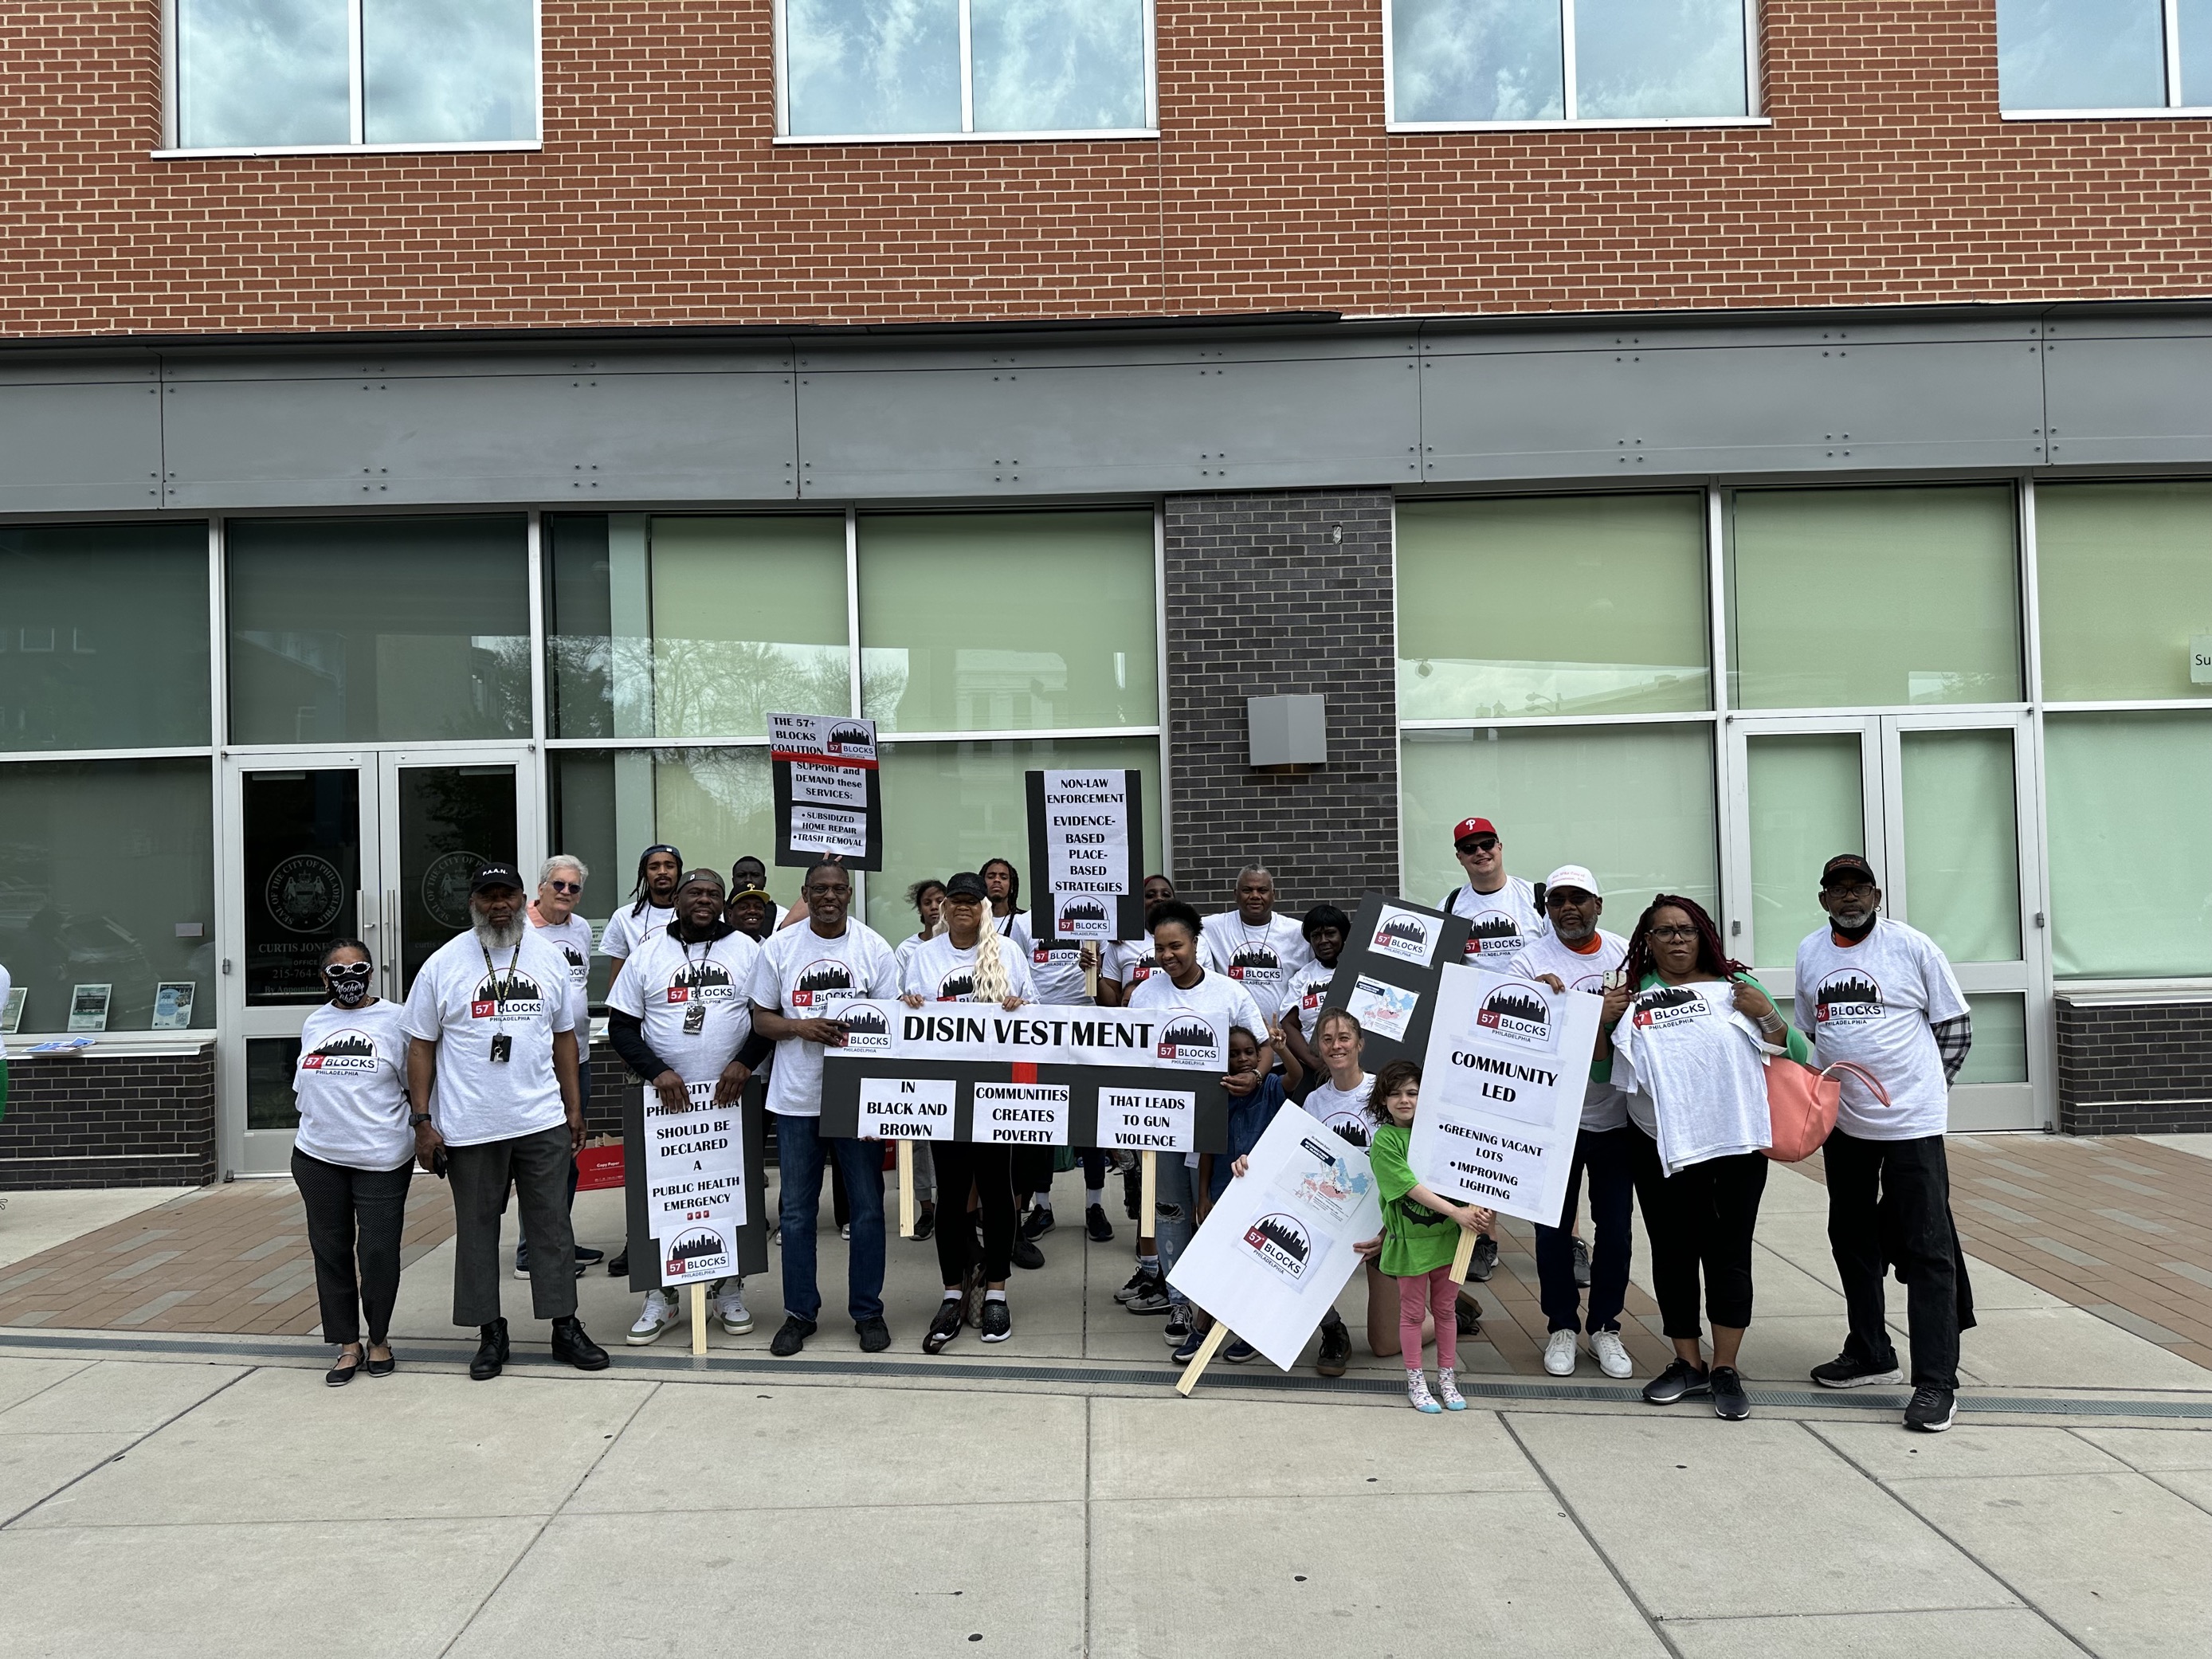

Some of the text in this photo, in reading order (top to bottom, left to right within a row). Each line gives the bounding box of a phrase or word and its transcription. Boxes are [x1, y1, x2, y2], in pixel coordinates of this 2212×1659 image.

[773, 717, 816, 728] THE 57+
[776, 730, 816, 741] BLOCKS
[771, 743, 824, 755] COALITION
[843, 746, 873, 755] BLOCKS
[797, 762, 839, 773] SUPPORT
[795, 775, 862, 789] DEMAND these
[1061, 779, 1109, 789] NON-LAW
[806, 787, 853, 800] SERVICES:
[1047, 794, 1124, 804] ENFORCEMENT
[806, 811, 854, 823] SUBSIDIZED
[1053, 816, 1116, 826] EVIDENCE-
[829, 824, 857, 835] REPAIR
[1465, 819, 1476, 830] P
[798, 833, 864, 846] TRASH REMOVAL
[1065, 833, 1104, 843] BASED
[1069, 849, 1108, 859] PLACE-
[428, 869, 440, 888] THE
[438, 856, 461, 870] CITY
[461, 856, 477, 865] OF
[1070, 865, 1107, 876] BASED
[271, 859, 340, 924] SEAL OF THE CITY OF PHILADELPHIA
[1055, 881, 1122, 892] STRATEGIES
[1076, 921, 1108, 931] BLOCKS
[258, 943, 298, 953] CURTIS
[1391, 939, 1423, 954] BLOCKS
[1482, 939, 1522, 950] BLOCKS
[1050, 951, 1080, 960] BLOCK
[814, 991, 853, 1002] BLOCKS
[1654, 1002, 1705, 1020] BLOCKS
[1831, 1006, 1881, 1017] BLOCKS
[1501, 1018, 1547, 1037] BLOCKS
[1648, 1018, 1694, 1030] PHILADELPHIA
[850, 1036, 888, 1045] BLOCKS
[1492, 1030, 1532, 1042] PHILADELPHIA
[1178, 1048, 1216, 1058] BLOCKS
[325, 1058, 375, 1069] BLOCKS
[1452, 1050, 1559, 1087] COMMUNITY
[900, 1081, 915, 1093] IN
[1482, 1082, 1516, 1103] LED
[975, 1087, 1068, 1101] COMMUNITIES
[1109, 1095, 1186, 1109] THAT LEADS
[867, 1101, 947, 1116] BLACK AND
[992, 1108, 1055, 1122] CREATES
[1122, 1114, 1170, 1128] TO GUN
[657, 1120, 731, 1139] SHOULD BE
[880, 1124, 932, 1136] BROWN
[993, 1128, 1053, 1143] POVERTY
[1115, 1133, 1177, 1147] VIOLENCE
[1444, 1124, 1544, 1157] GREENING VACANT
[661, 1138, 728, 1157] DECLARED
[1476, 1147, 1504, 1163] LOTS
[693, 1160, 703, 1171] A
[1457, 1162, 1519, 1186] IMPROVING
[653, 1176, 739, 1197] PUBLIC HEALTH
[1460, 1178, 1511, 1200] LIGHTING
[664, 1193, 731, 1211] EMERGENCY
[687, 1256, 727, 1270] BLOCKS
[1253, 1249, 1284, 1275] PHILADELPHIA
[1264, 1243, 1301, 1274] BLOCKS
[681, 1269, 716, 1278] PHILADELPHIA
